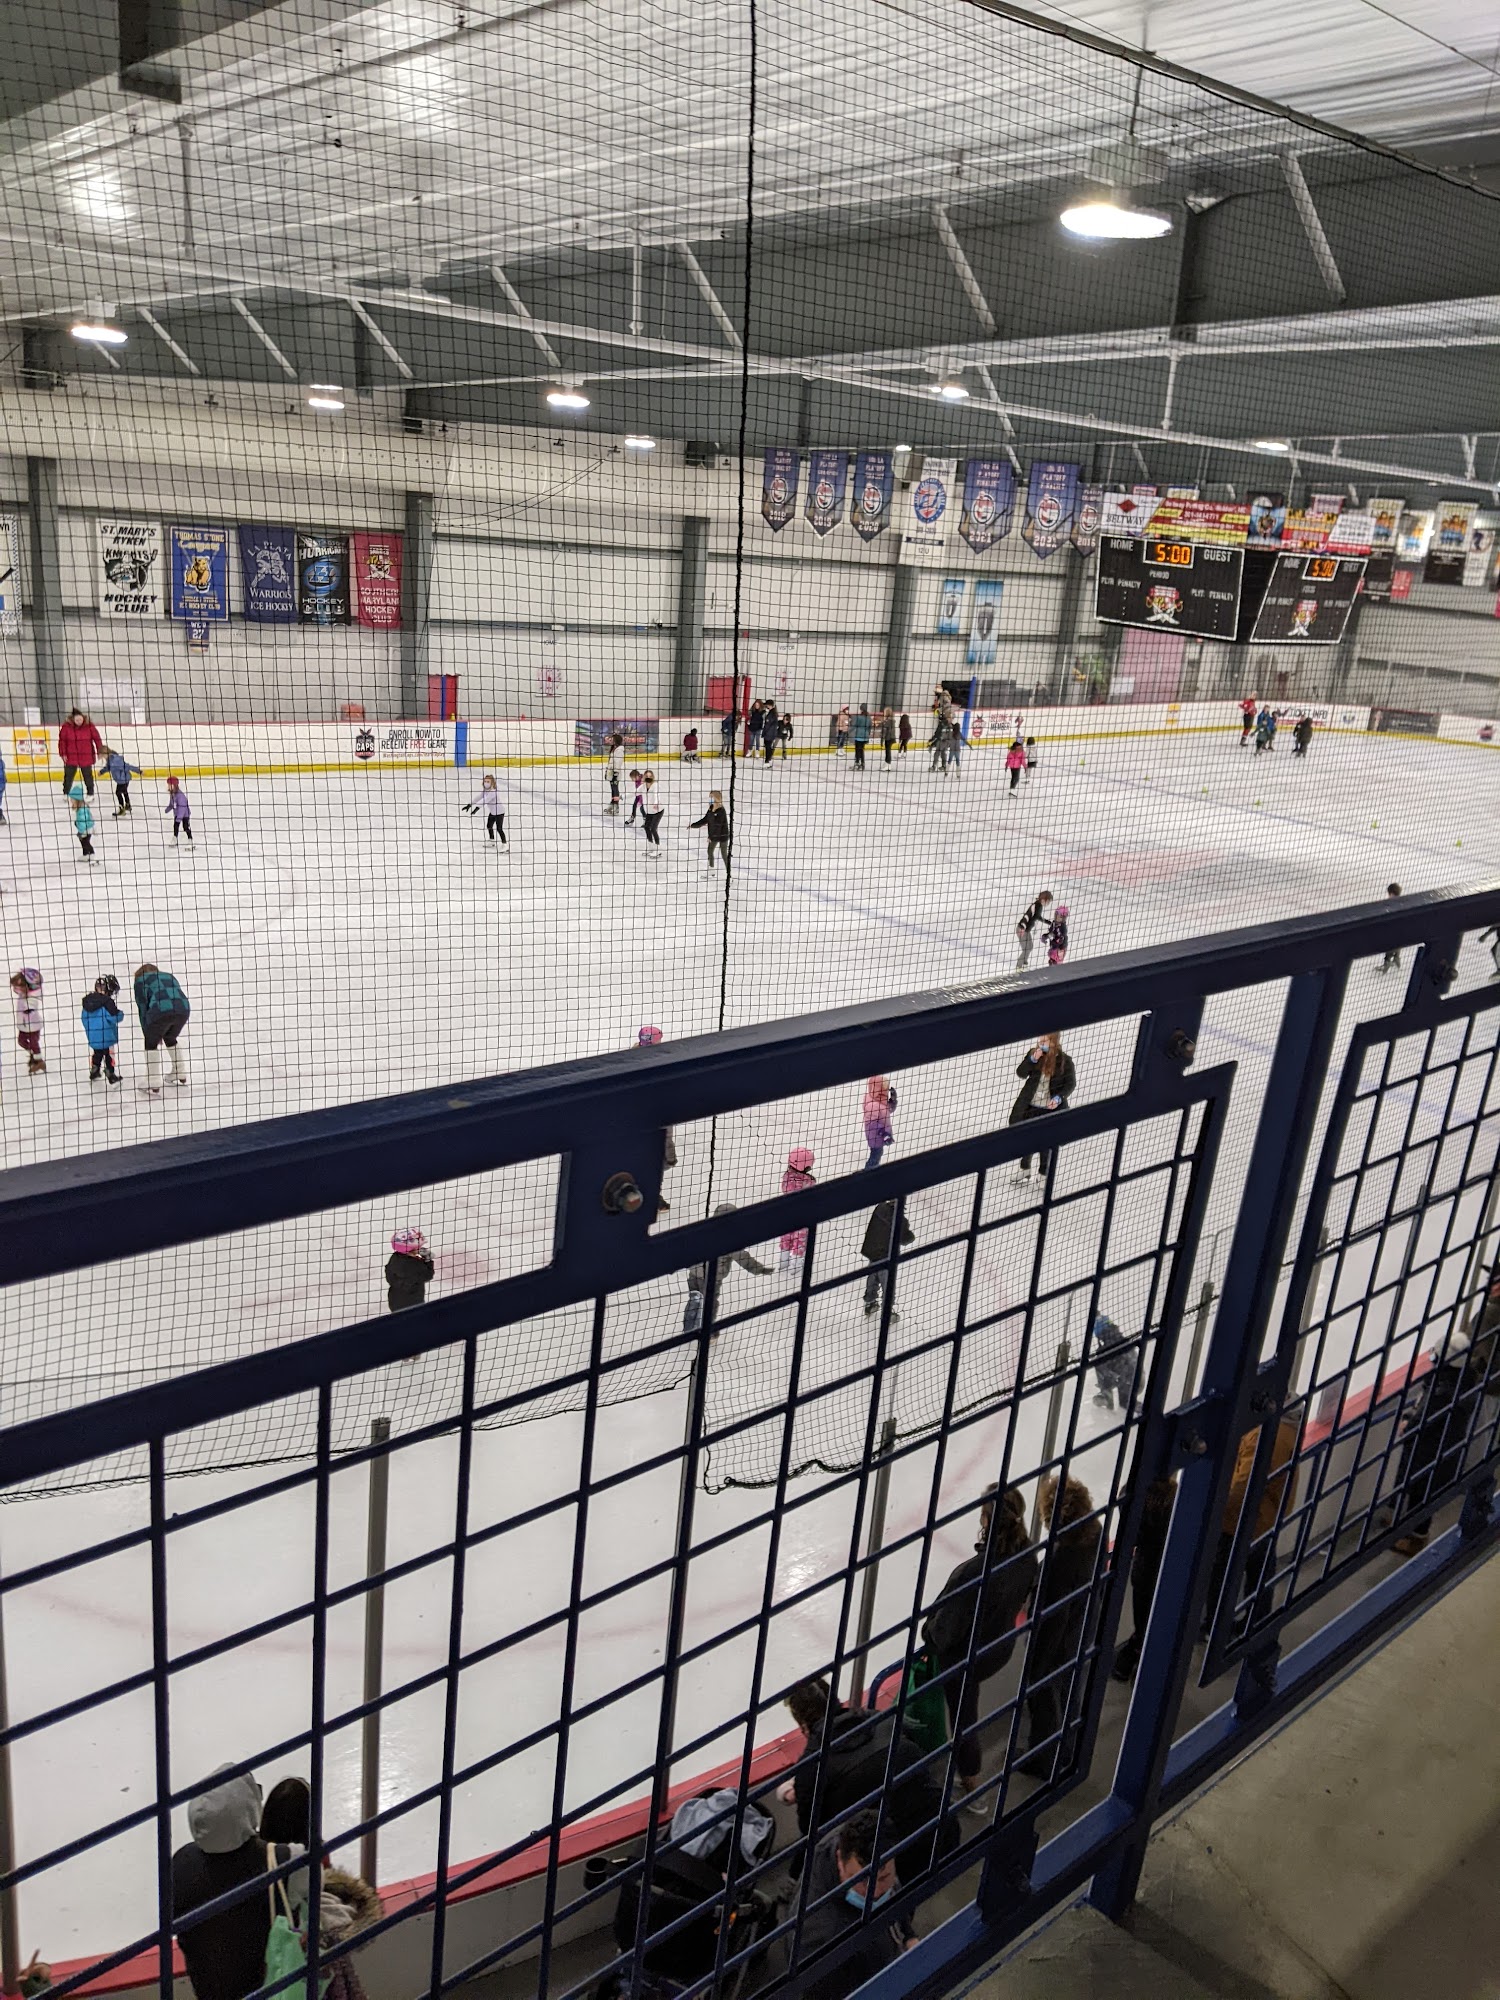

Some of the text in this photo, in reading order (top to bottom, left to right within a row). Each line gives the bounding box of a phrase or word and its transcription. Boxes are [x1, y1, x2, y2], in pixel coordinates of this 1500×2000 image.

[1107, 514, 1144, 526] BELTWAY
[101, 526, 157, 537] ST. MARY'S
[175, 531, 202, 540] THOMAS
[1110, 538, 1233, 564] HOME 5:00 GUEST
[250, 587, 292, 600] WARRIORS
[104, 594, 158, 604] HOCKEY
[114, 604, 150, 614] CLUB
[265, 602, 294, 612] HOCKEY
[365, 606, 398, 614] HOCKEY
[389, 729, 441, 740] ENROLL NOW TO
[356, 742, 374, 752] CAPS
[382, 739, 408, 750] RECEIVE
[410, 739, 426, 749] FREE
[428, 739, 448, 749] GEAR!
